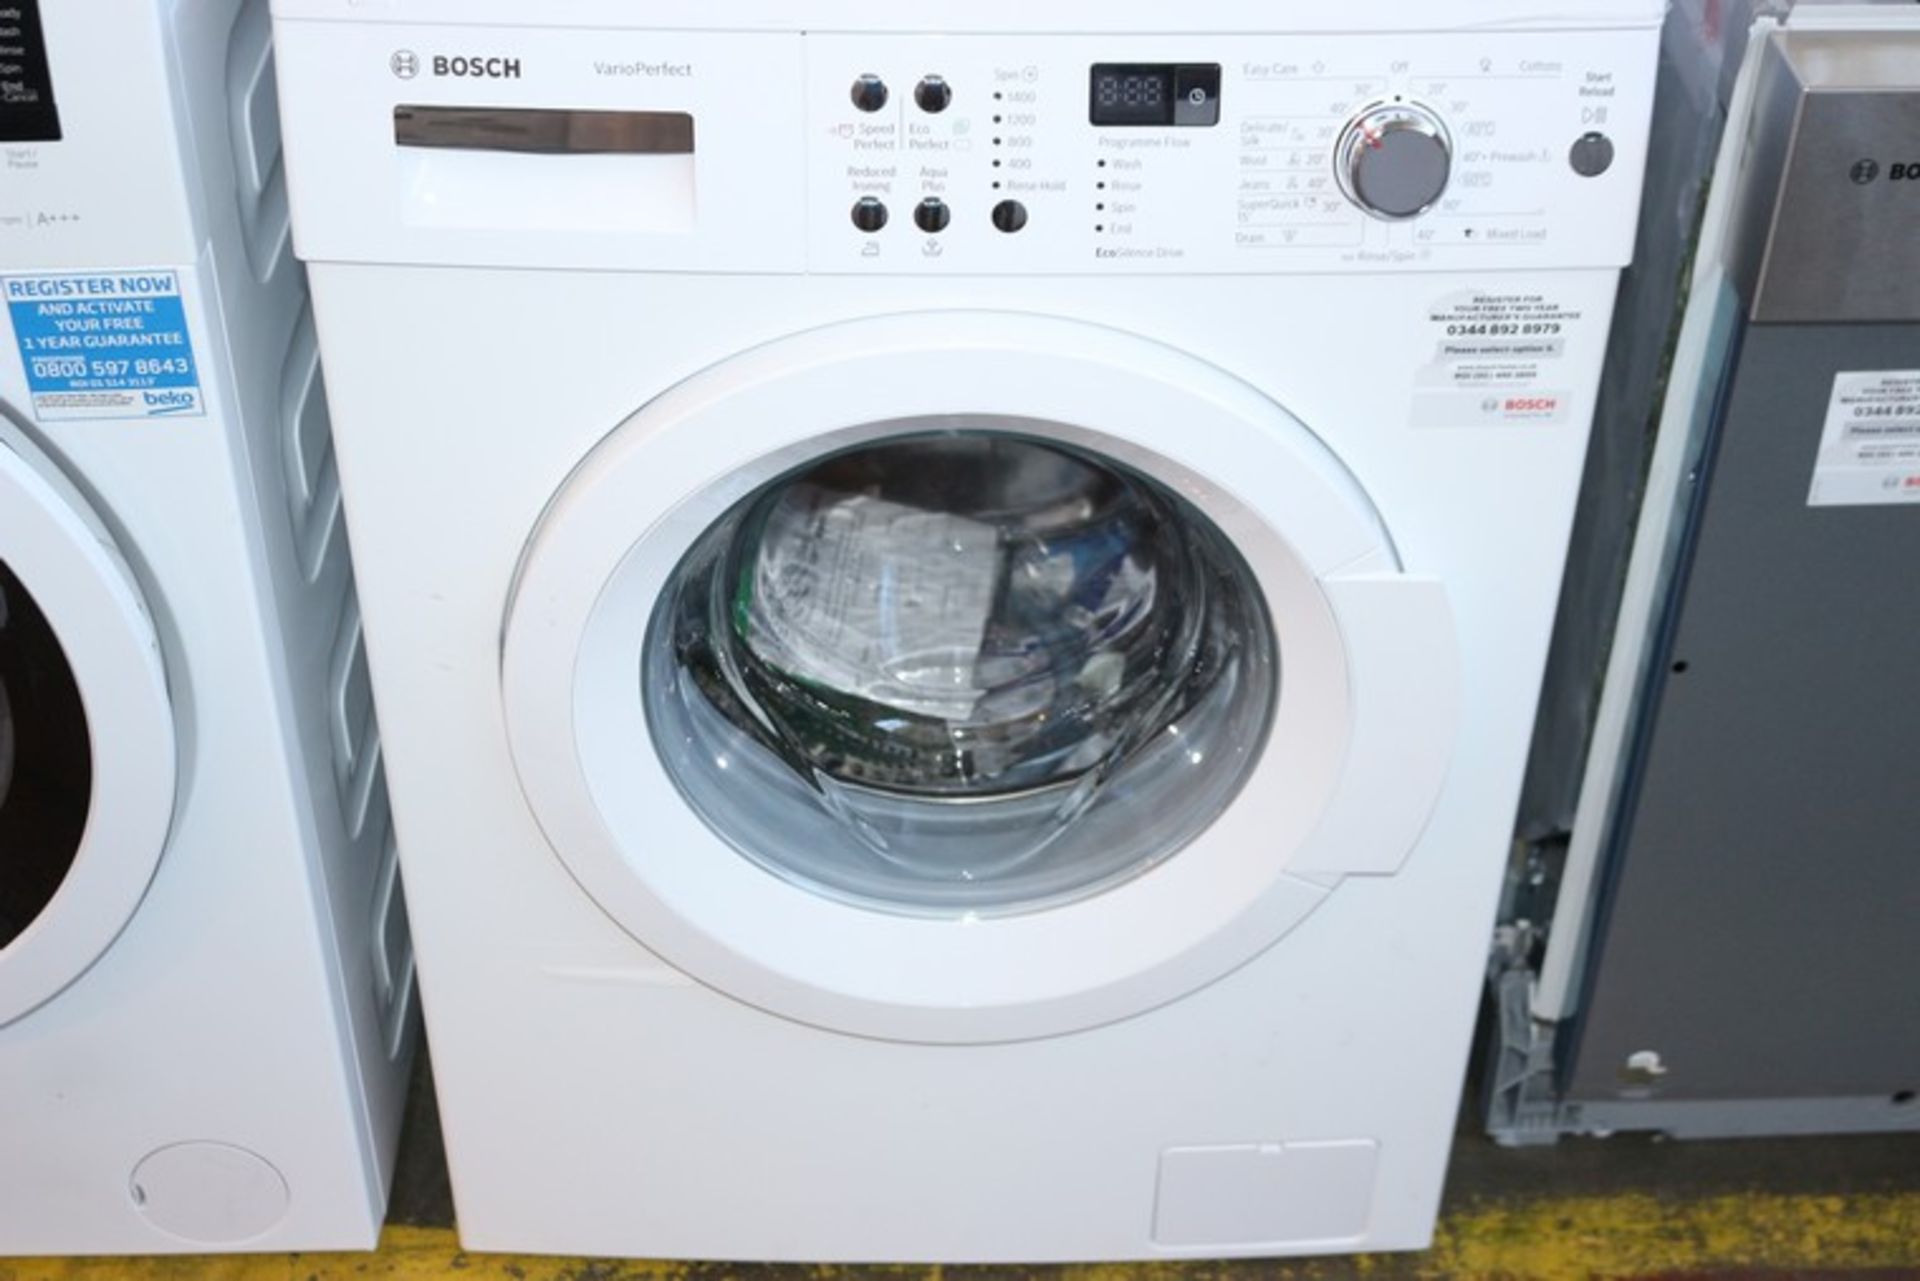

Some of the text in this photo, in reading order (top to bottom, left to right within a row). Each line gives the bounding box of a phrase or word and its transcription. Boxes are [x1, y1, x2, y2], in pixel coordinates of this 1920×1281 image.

[433, 56, 521, 79] BOSCH
[593, 61, 693, 78] VarioPerfect
[1391, 61, 1410, 73] Off
[993, 69, 1019, 82] Spin
[1586, 71, 1613, 82] Start
[1007, 91, 1036, 103] 1400
[1579, 86, 1615, 97] Reload
[1007, 114, 1036, 126] 1200
[858, 123, 896, 138] Speed
[909, 124, 931, 135] Eco
[854, 139, 896, 151] Perfect
[909, 138, 950, 151] Perfect
[1007, 136, 1033, 148] 800
[1098, 135, 1191, 150] Programme Flow
[1007, 158, 1032, 170] 400
[847, 166, 897, 178] Reduced
[919, 167, 948, 179] Aqua
[852, 181, 892, 194] Ironing
[921, 180, 945, 192] Plus
[1039, 180, 1067, 191] Hold
[1095, 246, 1184, 259] EcoSilence Drive
[9, 276, 173, 297] REGISTER NOW
[38, 300, 155, 316] AND ACTIVATE
[54, 317, 145, 332] YOUR FREE
[1447, 323, 1561, 336] 0344 892 8979
[24, 332, 183, 350] 1 YEAR GUARANTEE
[34, 358, 189, 379] 0800 597 8643
[143, 391, 195, 407] beko
[1504, 399, 1557, 410] BOSCH
